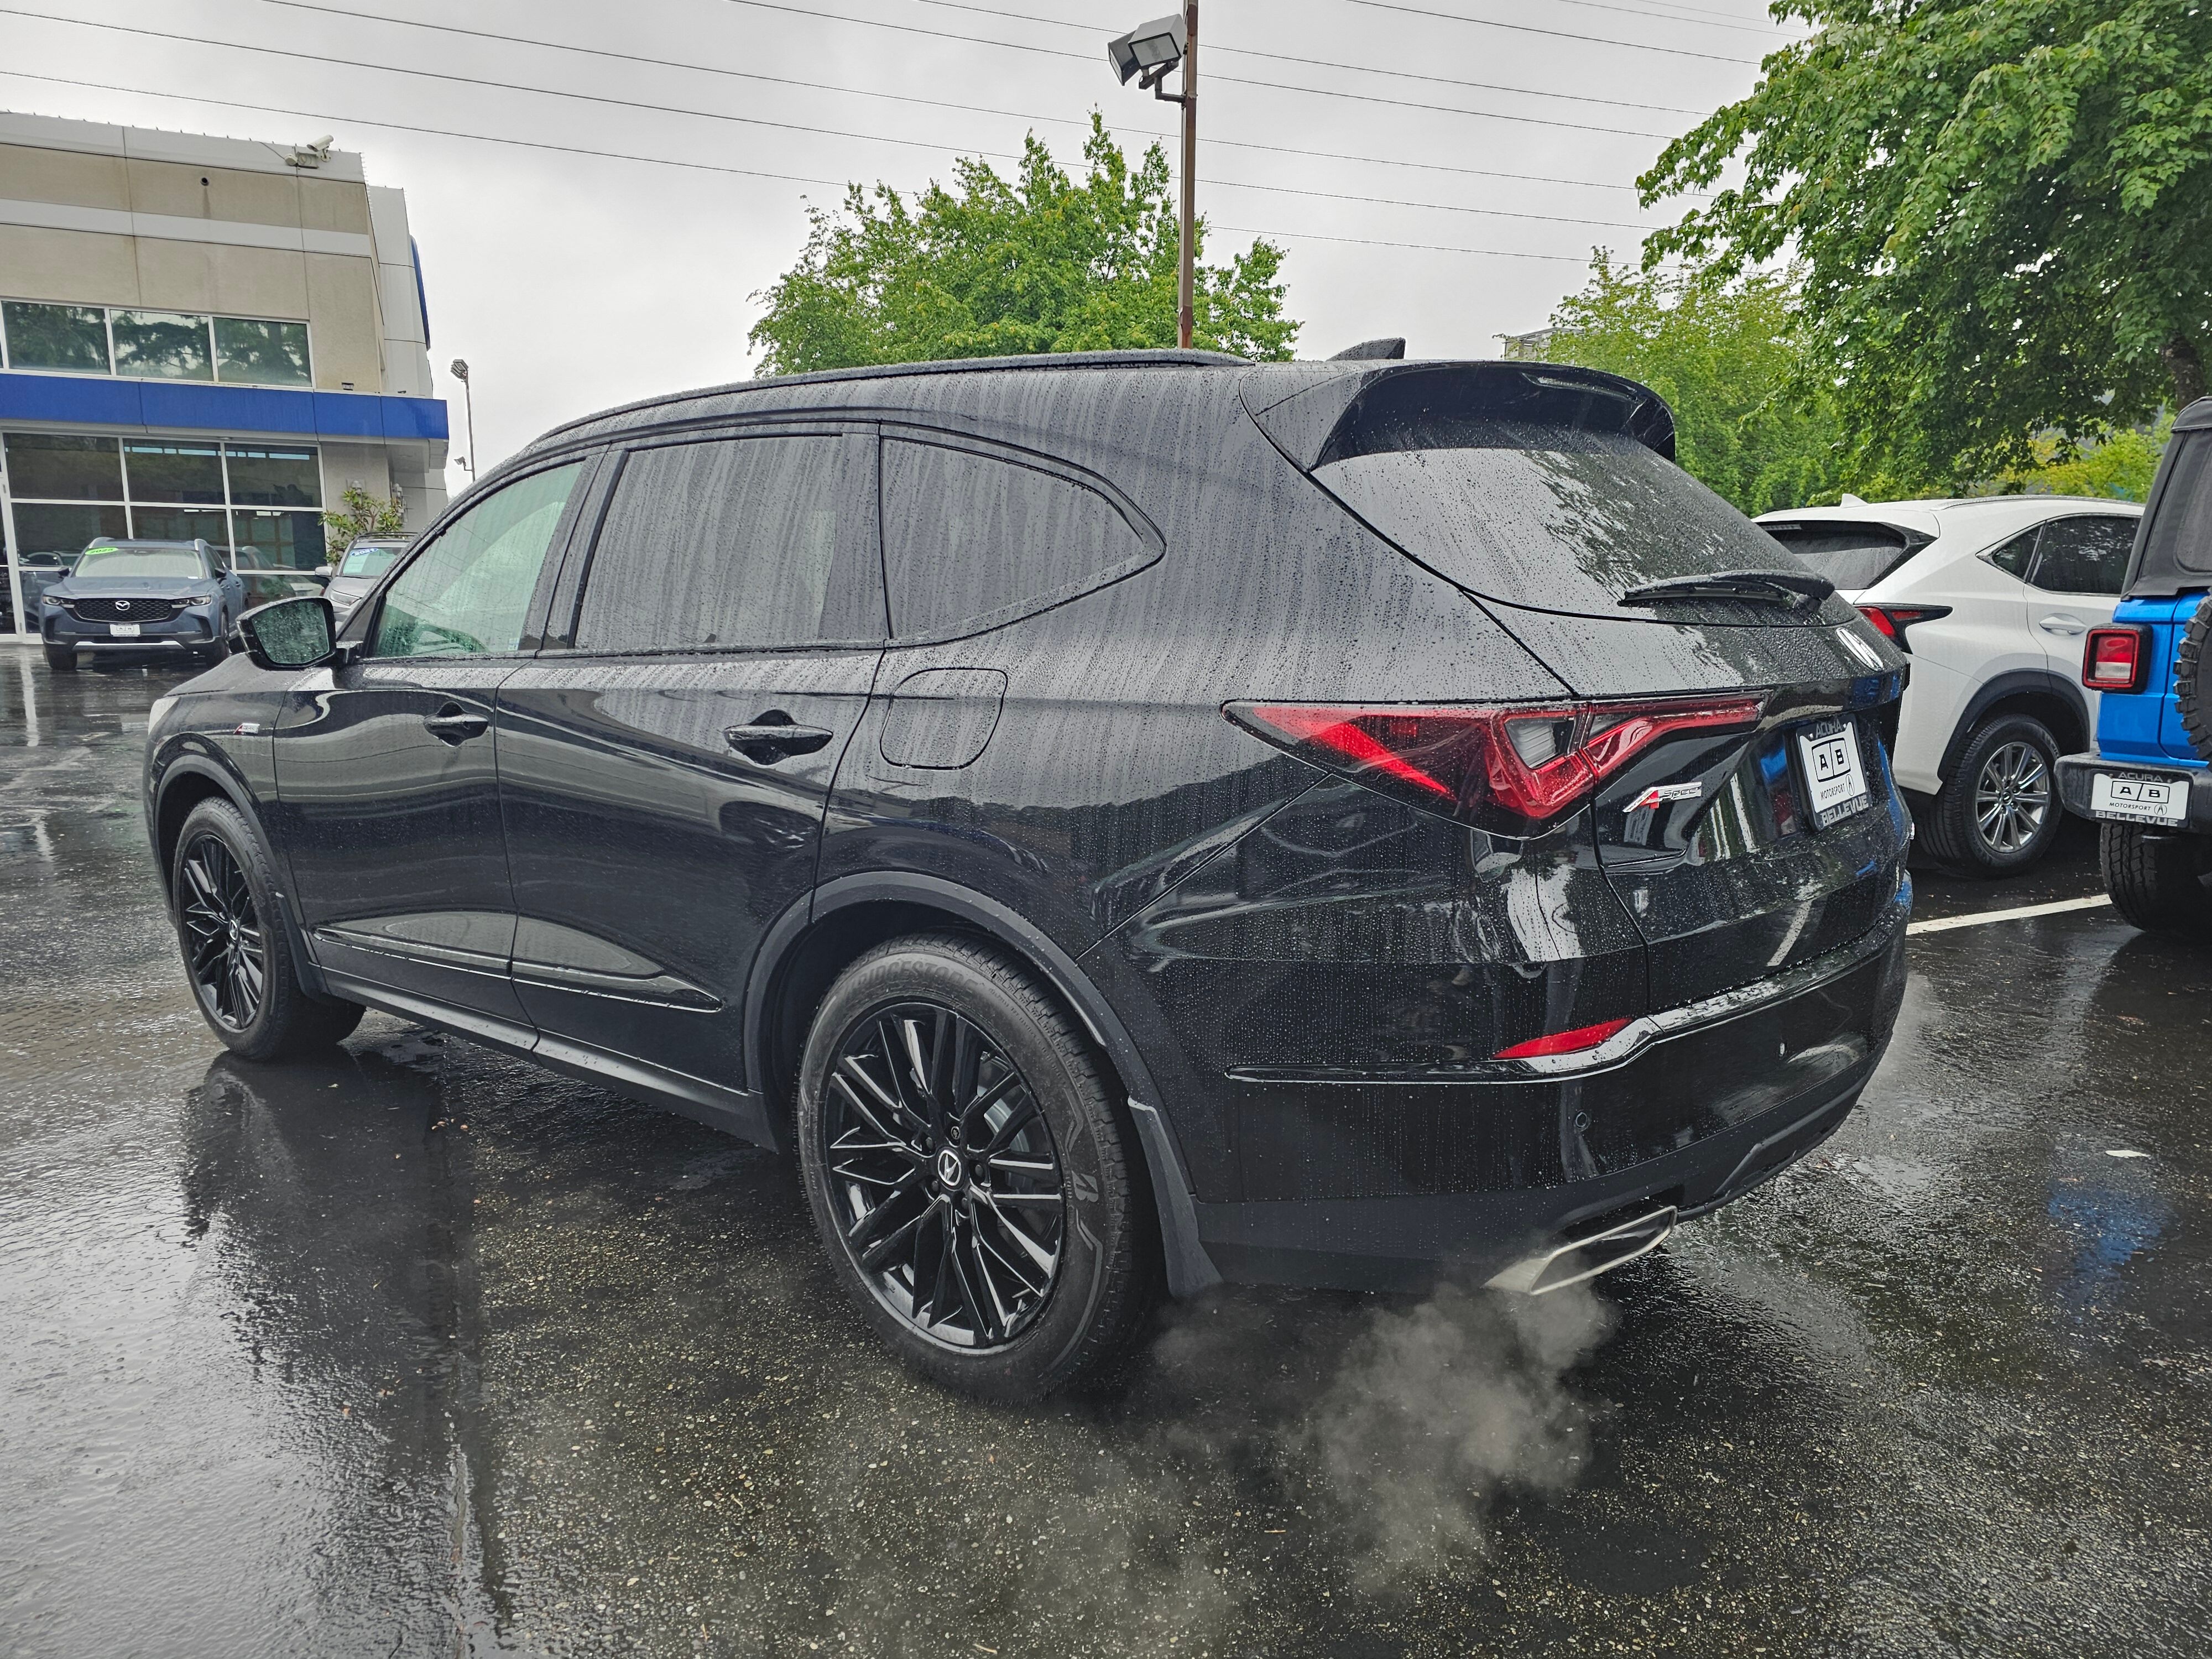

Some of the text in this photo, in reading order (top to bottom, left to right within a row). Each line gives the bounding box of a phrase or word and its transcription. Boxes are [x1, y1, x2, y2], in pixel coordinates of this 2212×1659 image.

[1815, 719, 1842, 739] ACURA
[2118, 772, 2163, 782] ACURA
[1820, 783, 1845, 801] MOTORSPORT
[1820, 795, 1869, 827] BELLEVUE
[2109, 802, 2151, 811] MOTORSPORT
[2095, 810, 2178, 827] BELLEVUE
